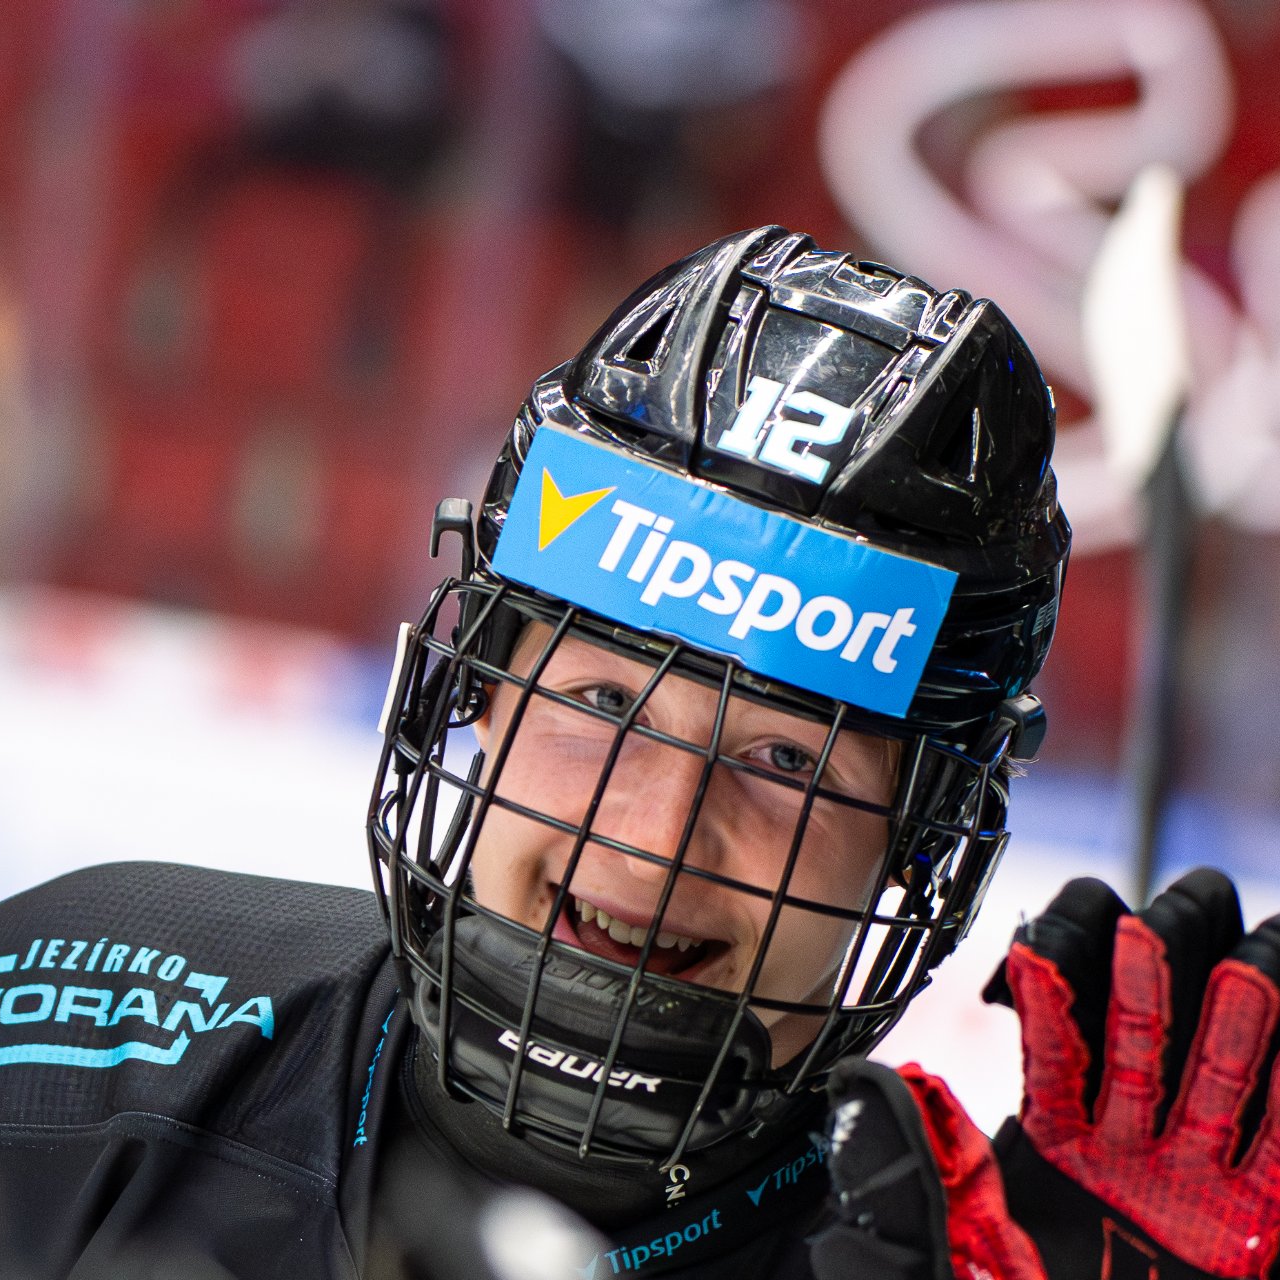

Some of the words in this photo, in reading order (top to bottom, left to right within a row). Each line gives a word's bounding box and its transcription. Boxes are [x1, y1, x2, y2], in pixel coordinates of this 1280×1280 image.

[717, 375, 855, 485] 12
[598, 499, 918, 673] Tipsport
[19, 937, 187, 982] JEZÍRKO
[604, 1207, 723, 1275] Tipsport
